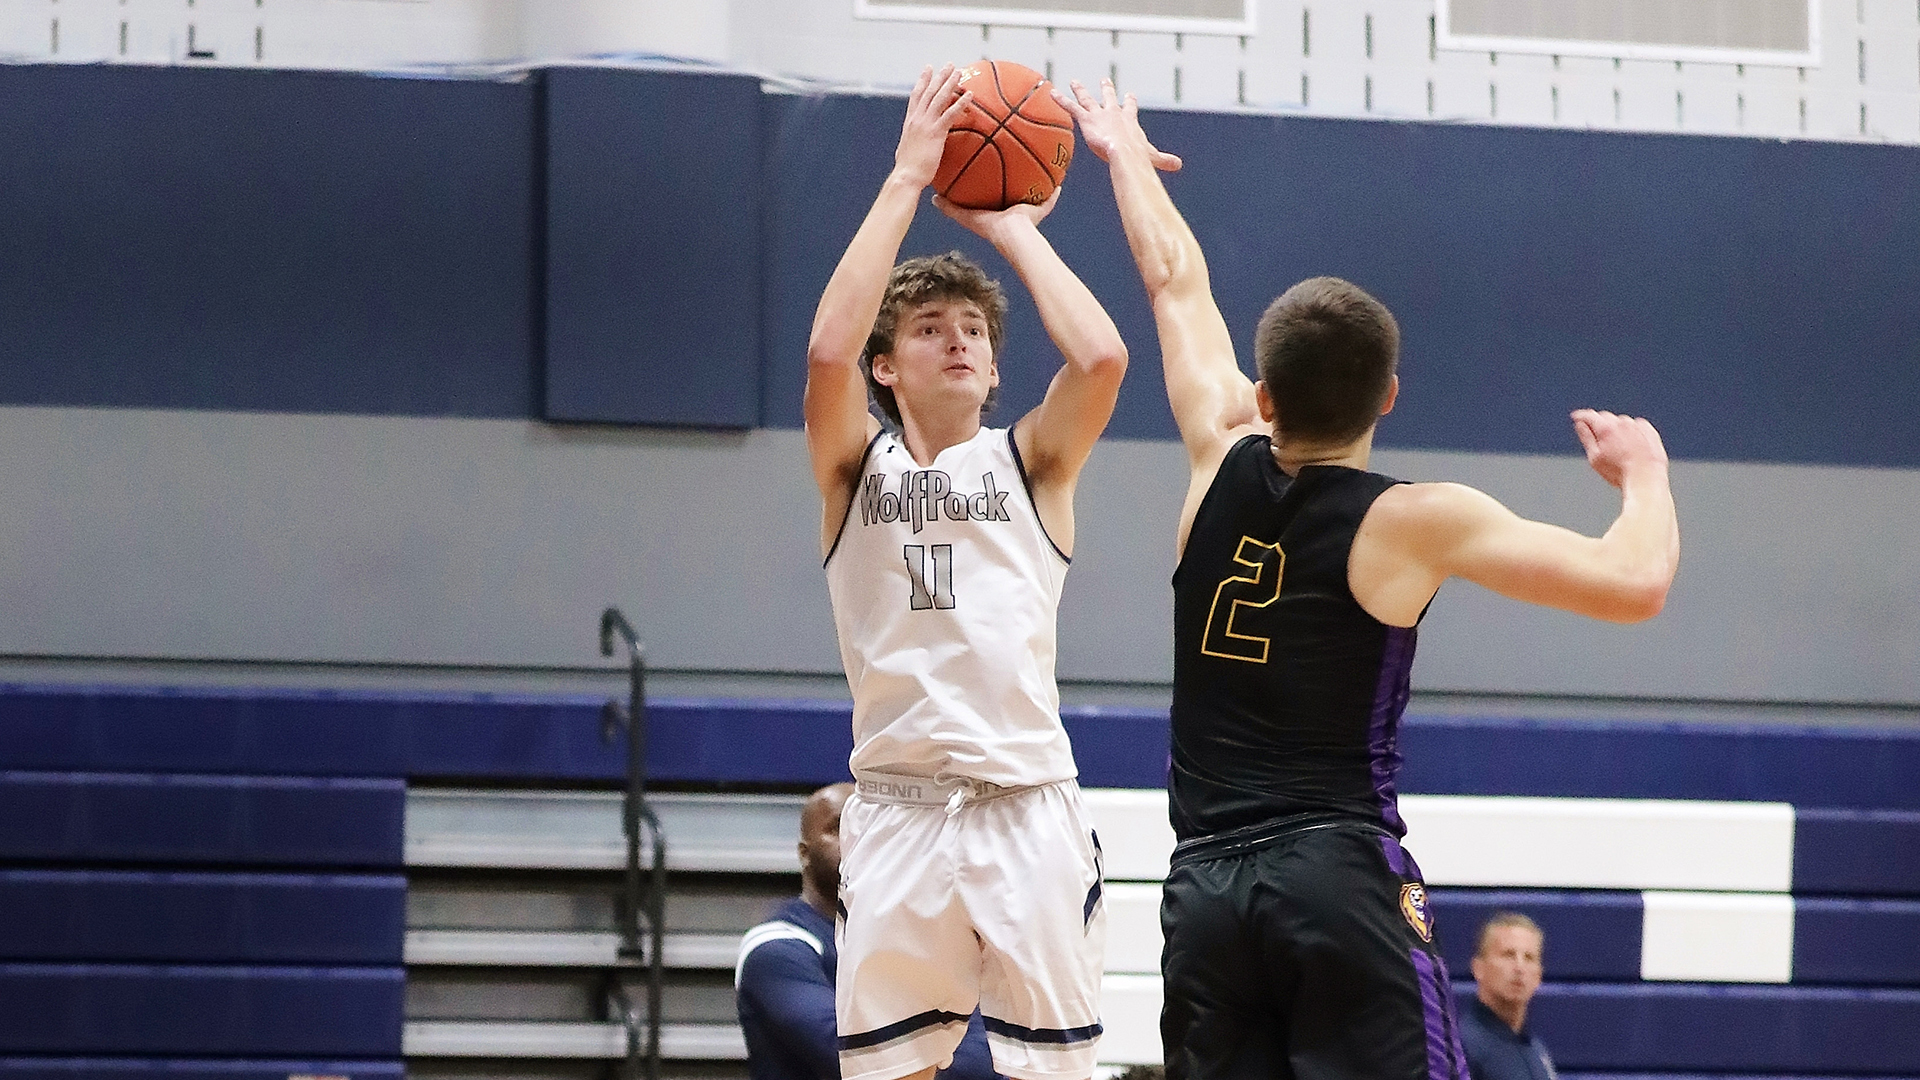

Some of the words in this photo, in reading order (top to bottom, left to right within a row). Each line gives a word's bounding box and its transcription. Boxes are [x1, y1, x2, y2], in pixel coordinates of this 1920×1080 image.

[860, 470, 1011, 534] WolfPack
[903, 544, 956, 611] 11
[1201, 535, 1286, 664] 2
[858, 780, 922, 799] UNDER
